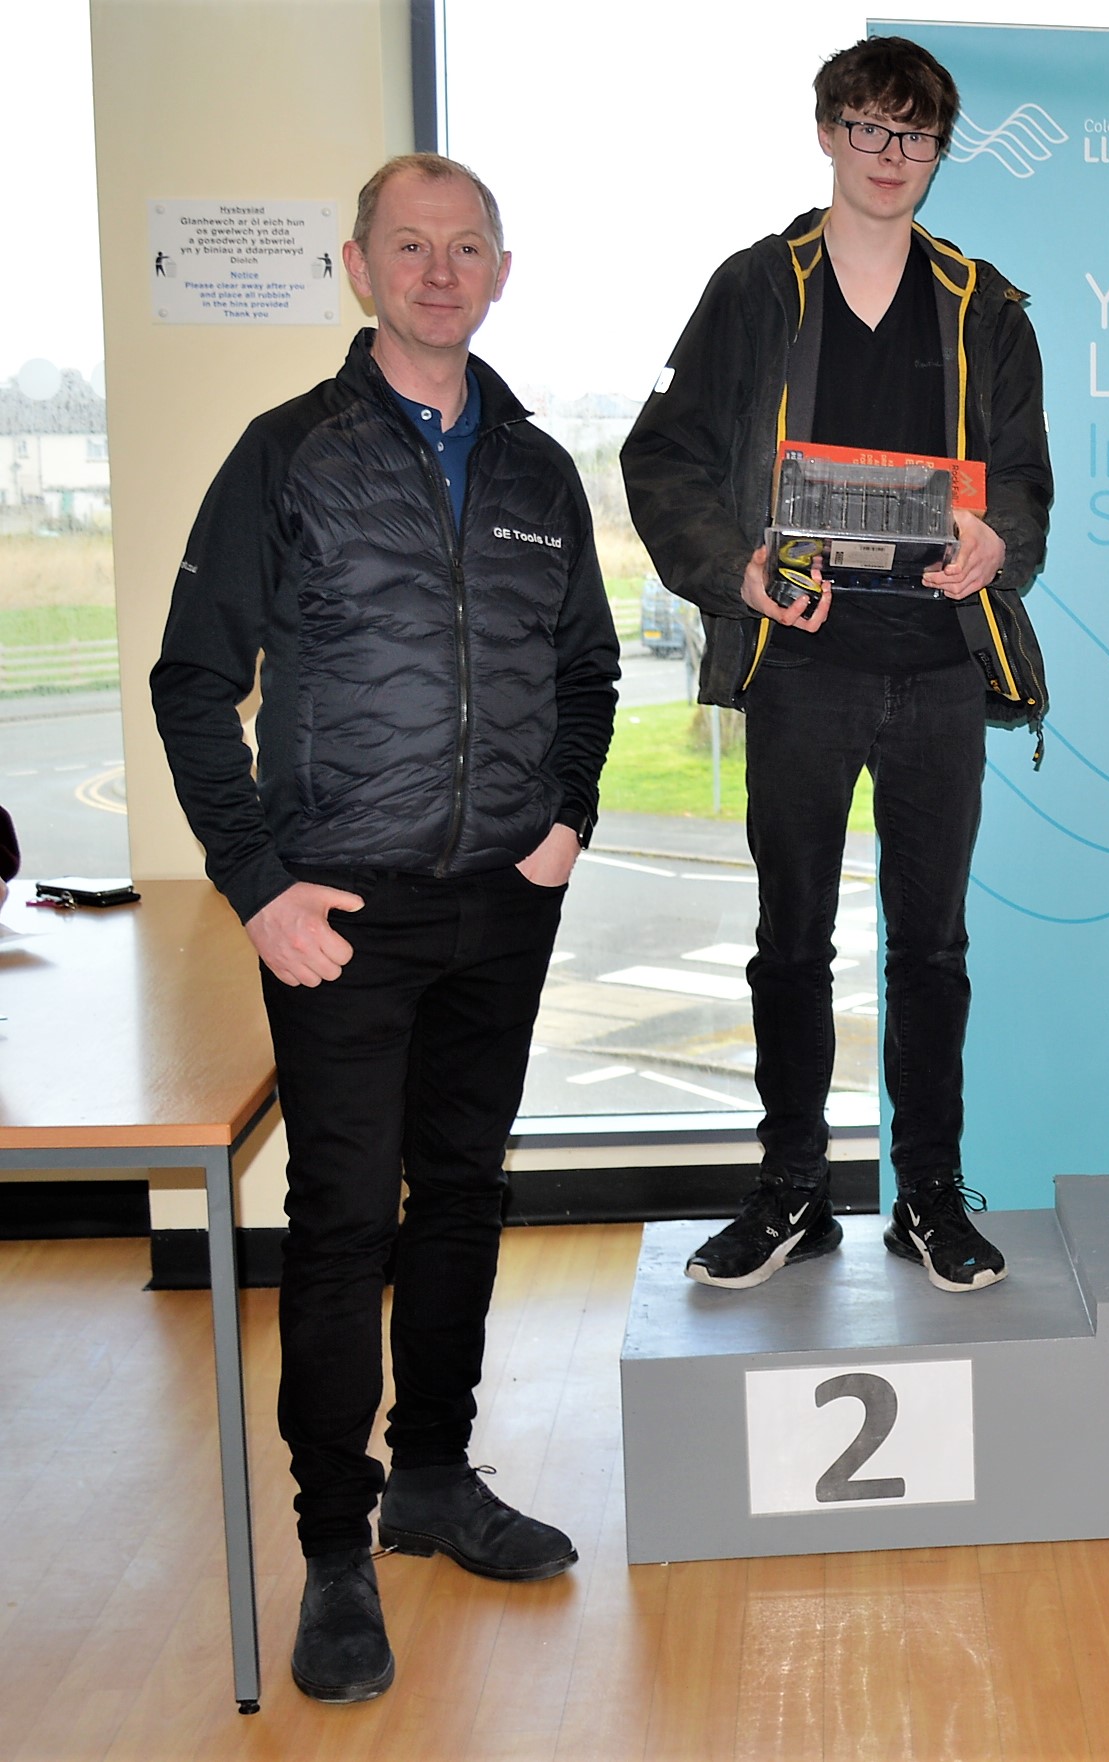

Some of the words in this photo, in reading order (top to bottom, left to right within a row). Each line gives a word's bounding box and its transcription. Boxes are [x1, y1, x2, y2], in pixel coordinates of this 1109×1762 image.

[493, 526, 512, 540] GE
[513, 530, 544, 545] Tools
[544, 536, 562, 548] Ltd
[814, 1372, 906, 1502] 2
